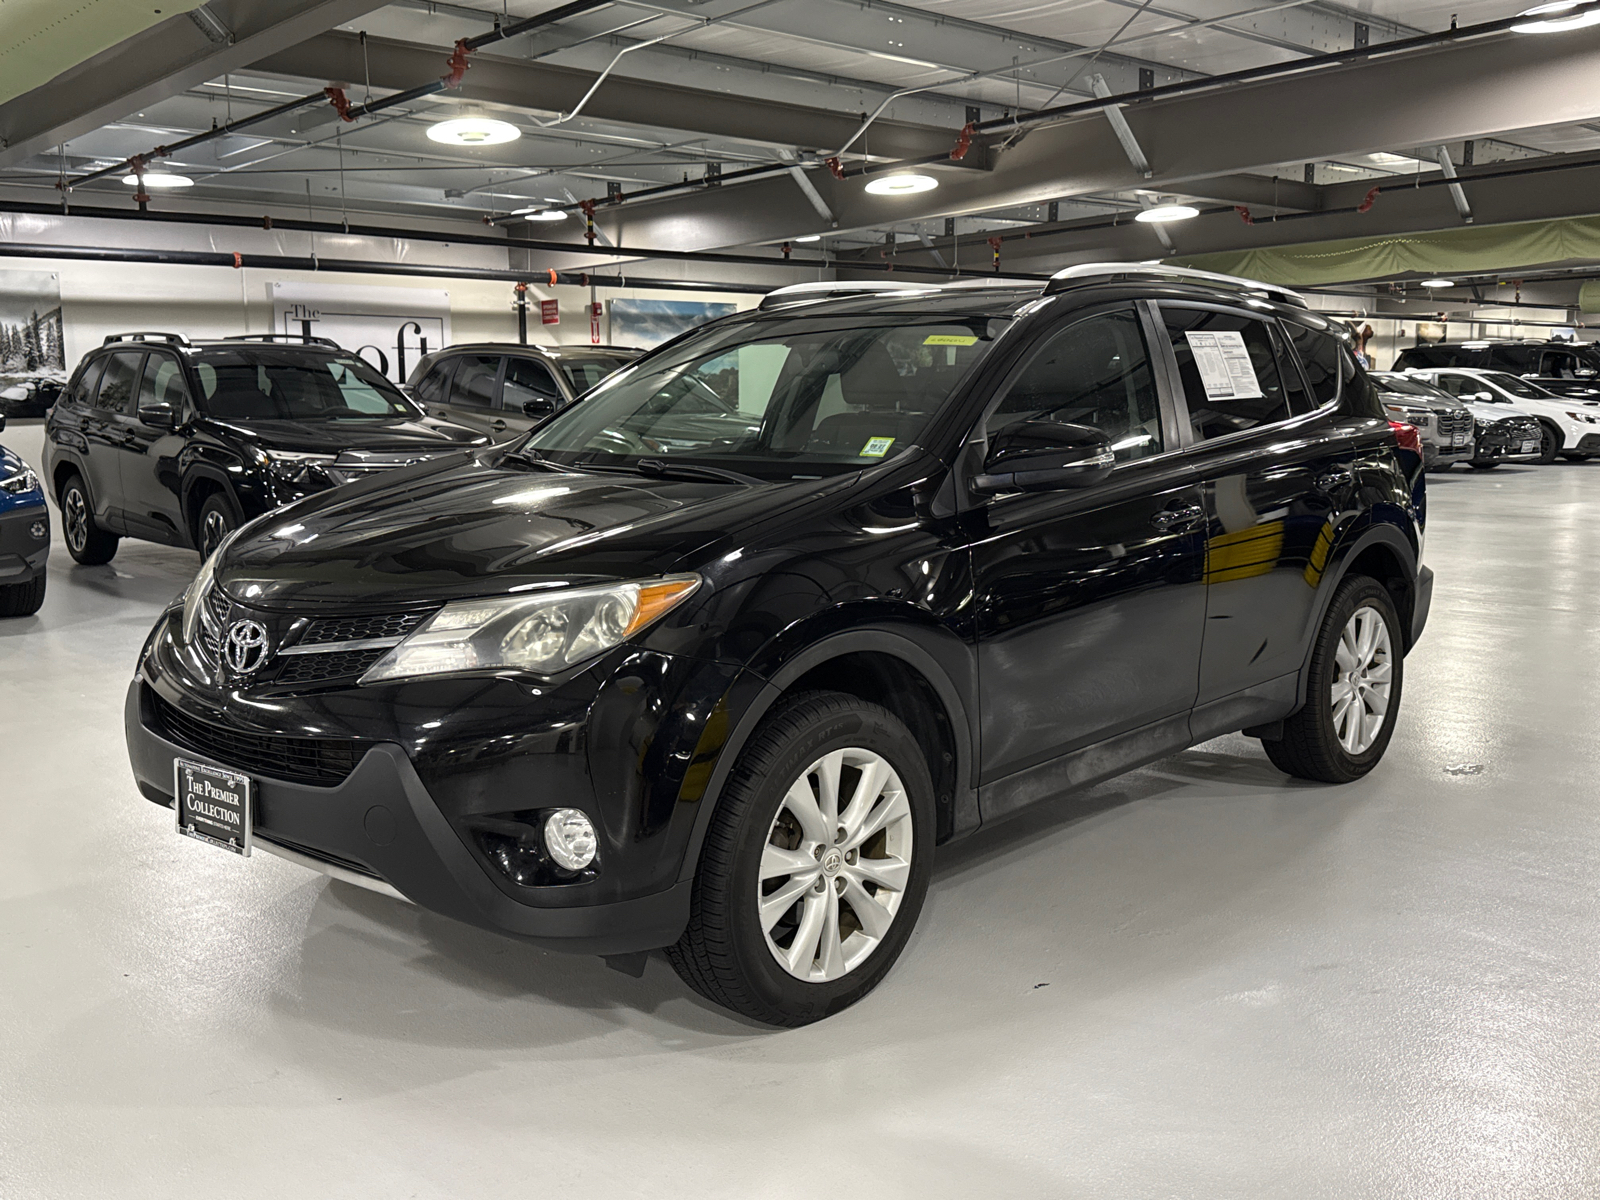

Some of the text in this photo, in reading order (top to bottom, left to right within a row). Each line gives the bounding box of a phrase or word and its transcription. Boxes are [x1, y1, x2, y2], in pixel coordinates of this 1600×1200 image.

[290, 304, 321, 318] The
[769, 739, 814, 800] ALTIMAX
[186, 776, 240, 806] THE PREMIER
[187, 793, 240, 825] COLLECTION
